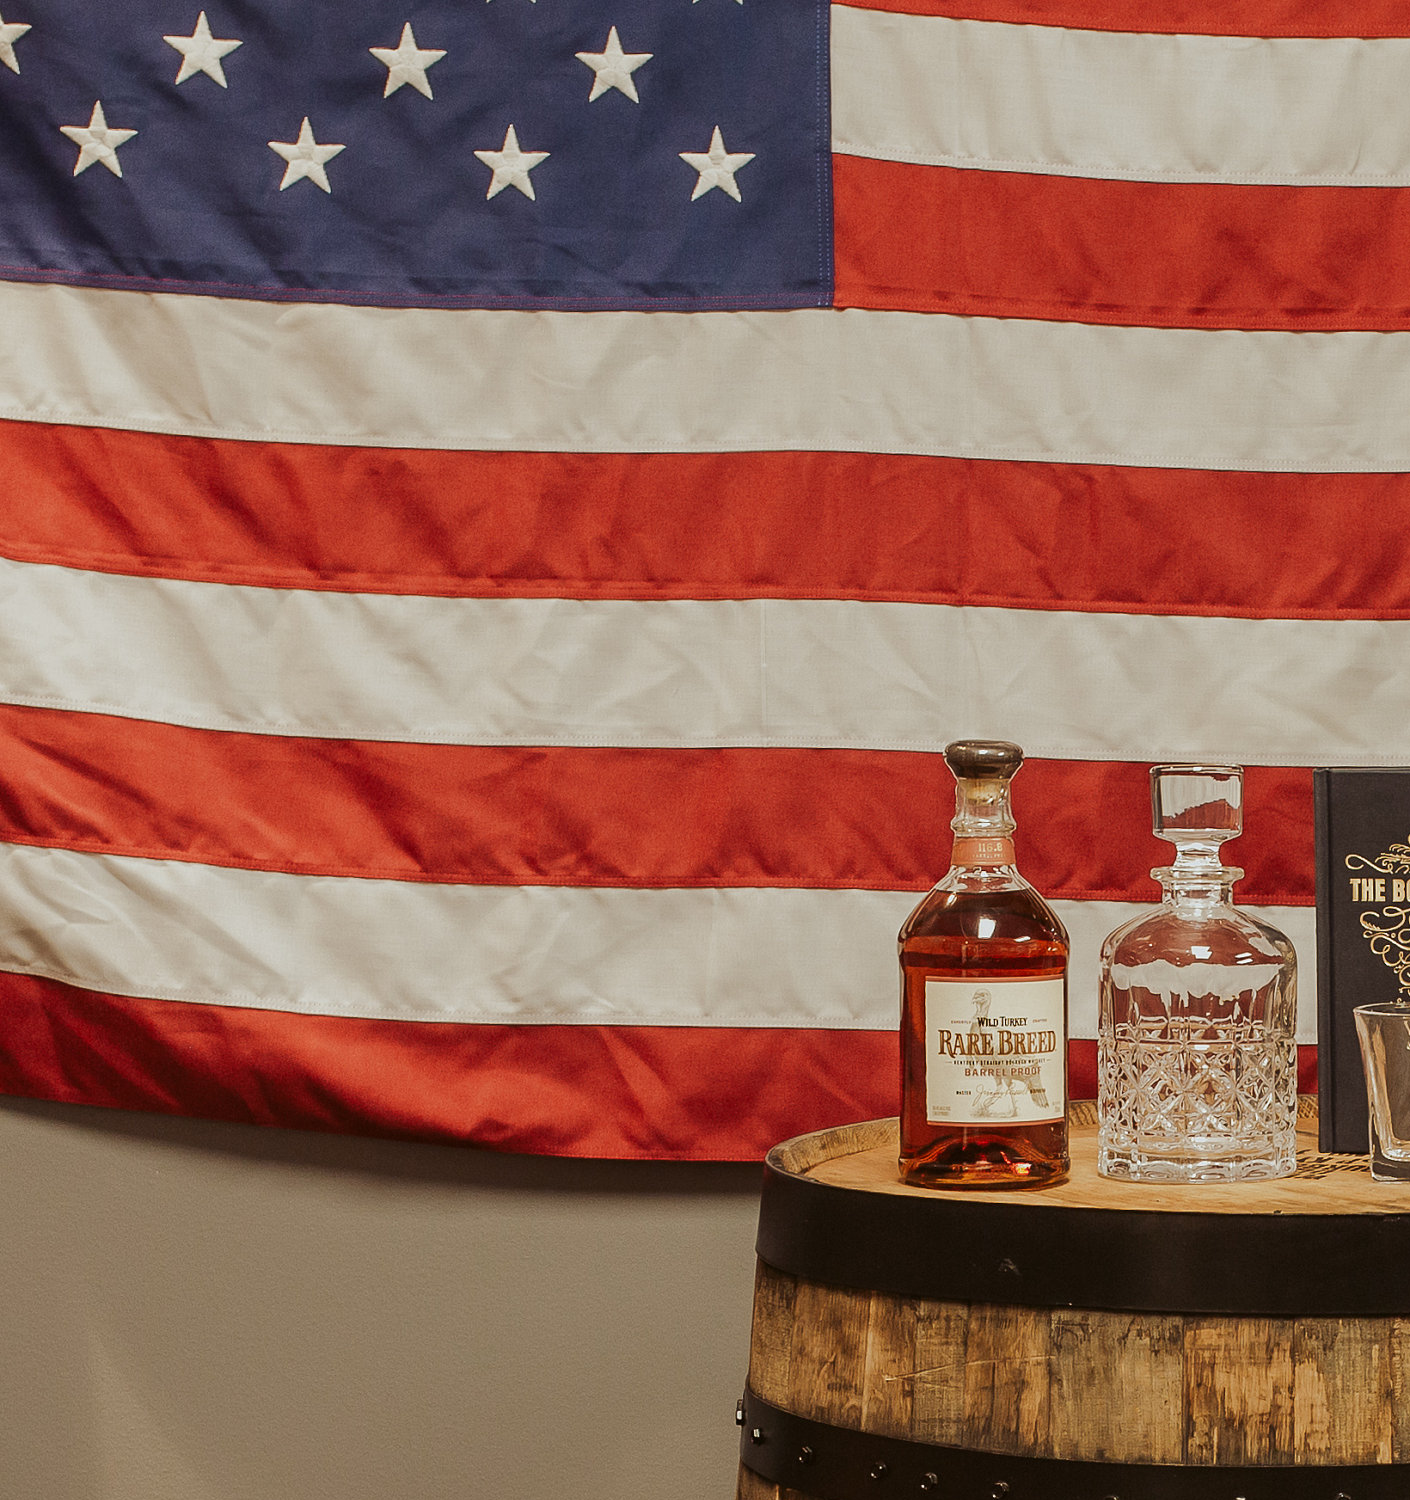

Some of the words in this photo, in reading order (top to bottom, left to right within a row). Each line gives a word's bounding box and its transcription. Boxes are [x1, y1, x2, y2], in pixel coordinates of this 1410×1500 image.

[1349, 878, 1386, 902] THE
[977, 1017, 999, 1027] WILD
[999, 1016, 1028, 1027] TURKEY
[938, 1030, 994, 1058] RARE
[997, 1031, 1056, 1055] BREED
[964, 1067, 1007, 1077] BARREL
[1010, 1066, 1042, 1076] PROOF
